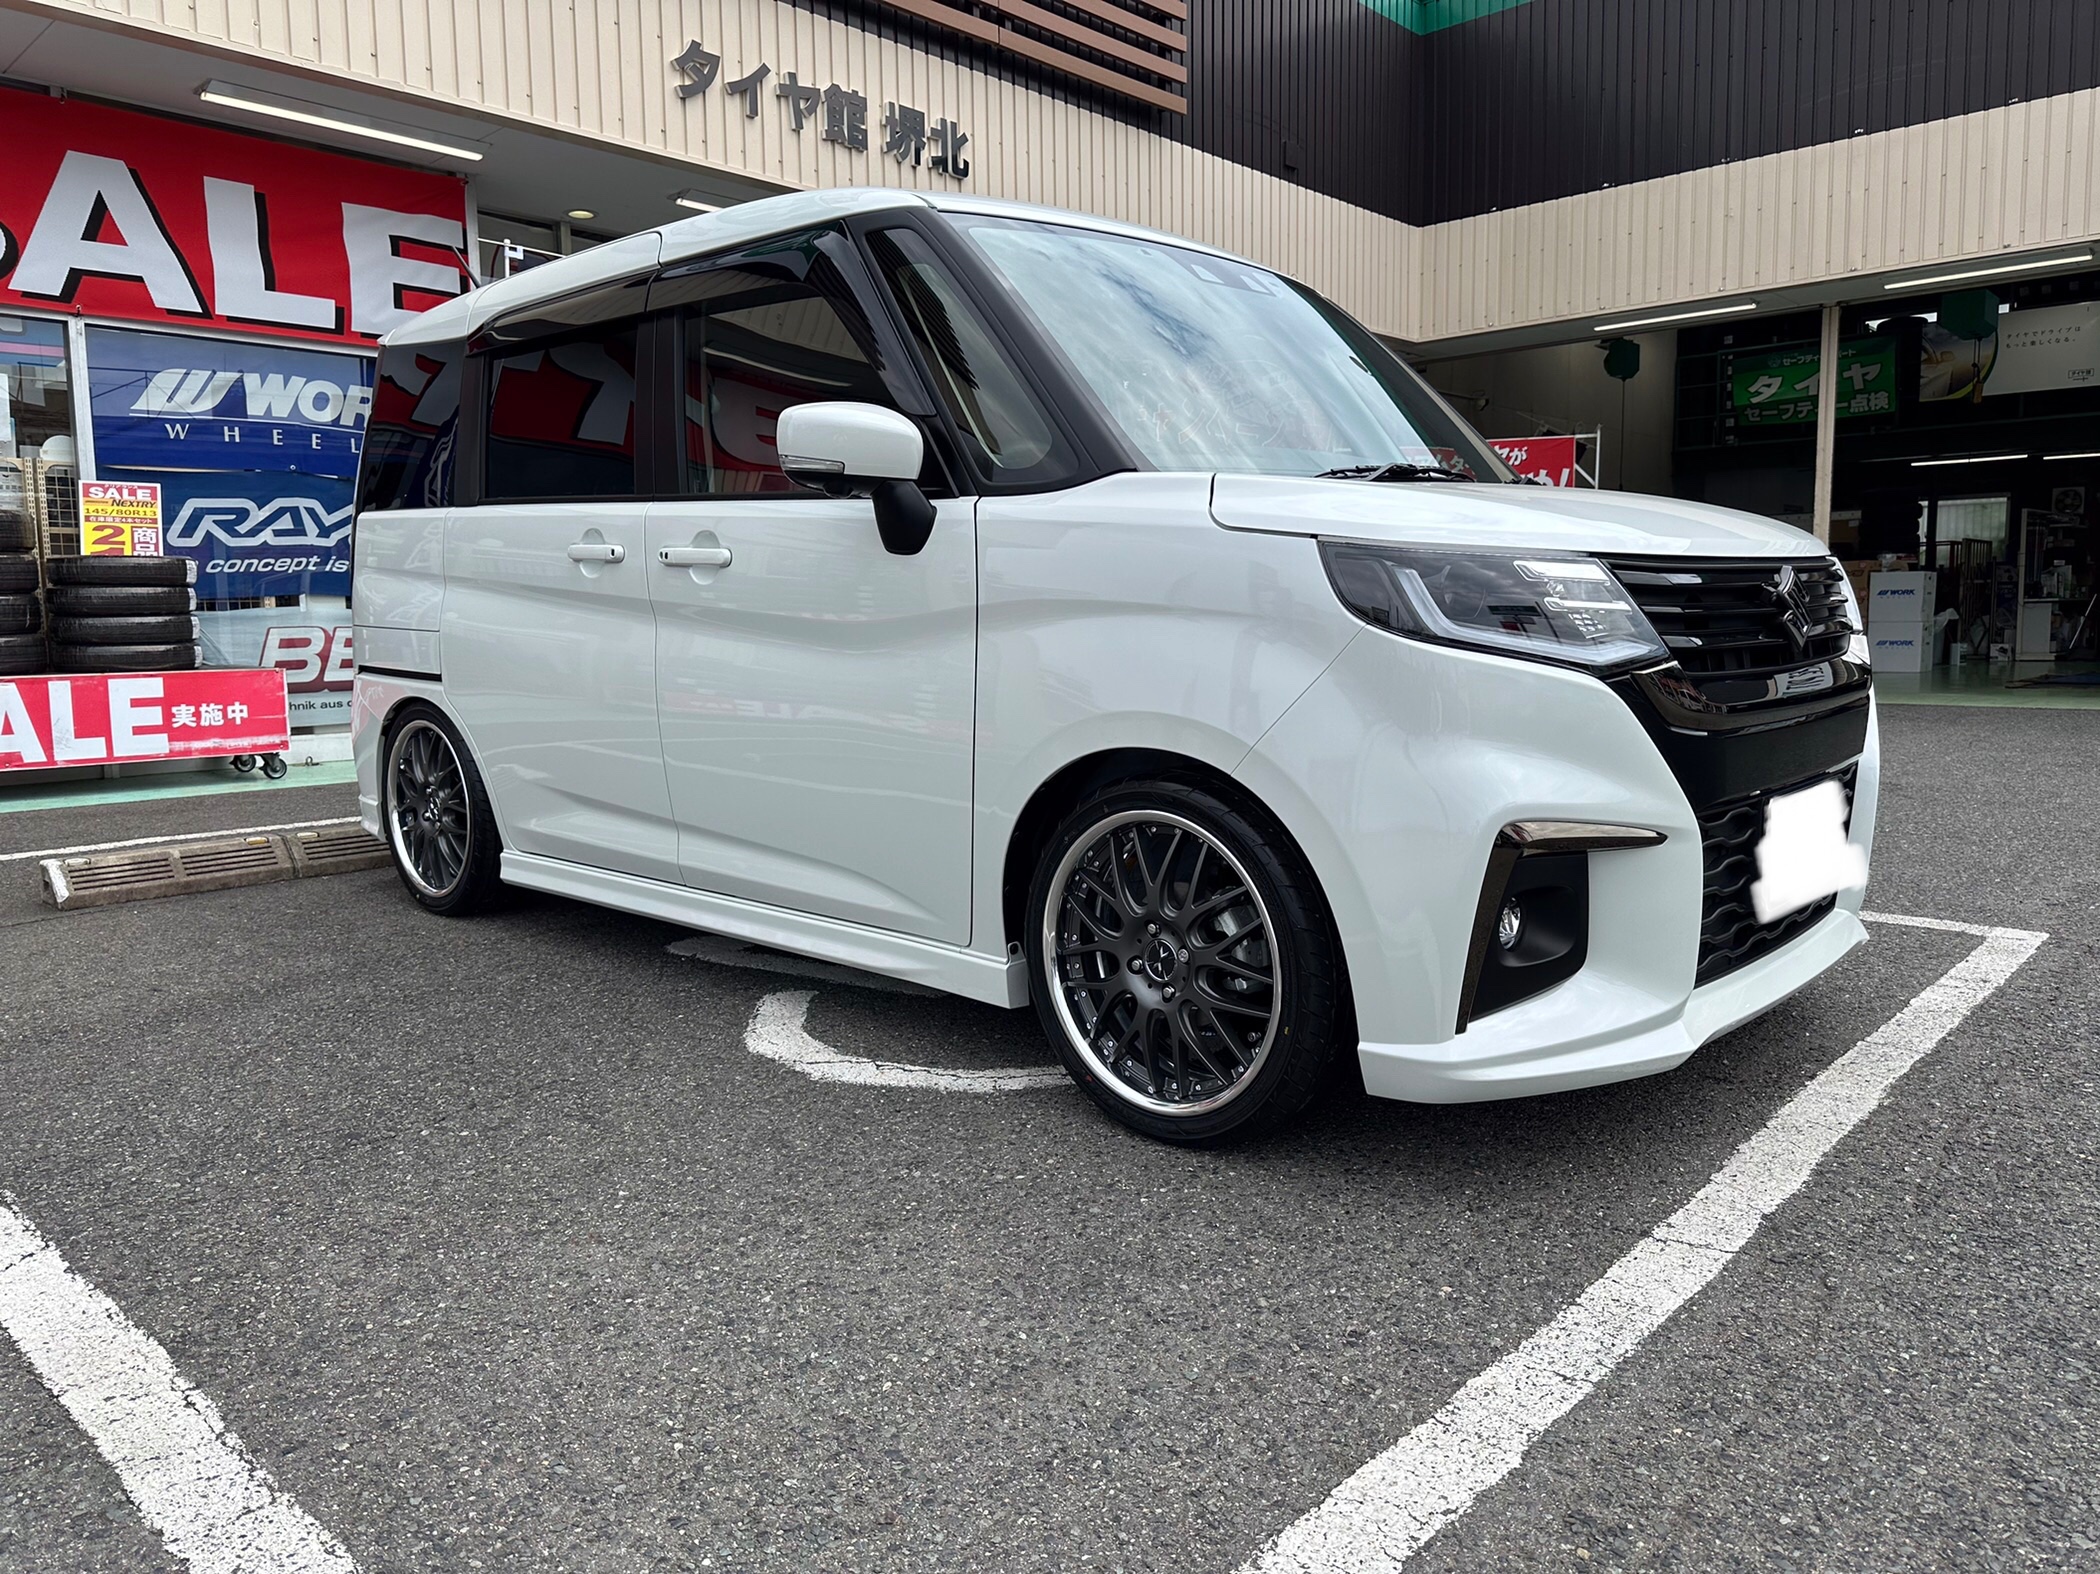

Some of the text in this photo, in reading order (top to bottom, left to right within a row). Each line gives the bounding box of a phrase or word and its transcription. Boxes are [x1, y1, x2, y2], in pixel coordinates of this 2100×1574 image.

[670, 38, 970, 180] タイヤ館 堺北
[0, 149, 464, 335] ALE
[1744, 391, 1889, 421] セーフテー点検
[88, 487, 152, 500] SALE
[111, 499, 157, 508] NEXTRY
[85, 508, 157, 517] 145/80R13
[167, 497, 354, 547] RAY
[206, 556, 319, 574] concept
[325, 556, 349, 573] is
[171, 702, 249, 728] 実施中
[320, 701, 343, 709] aus
